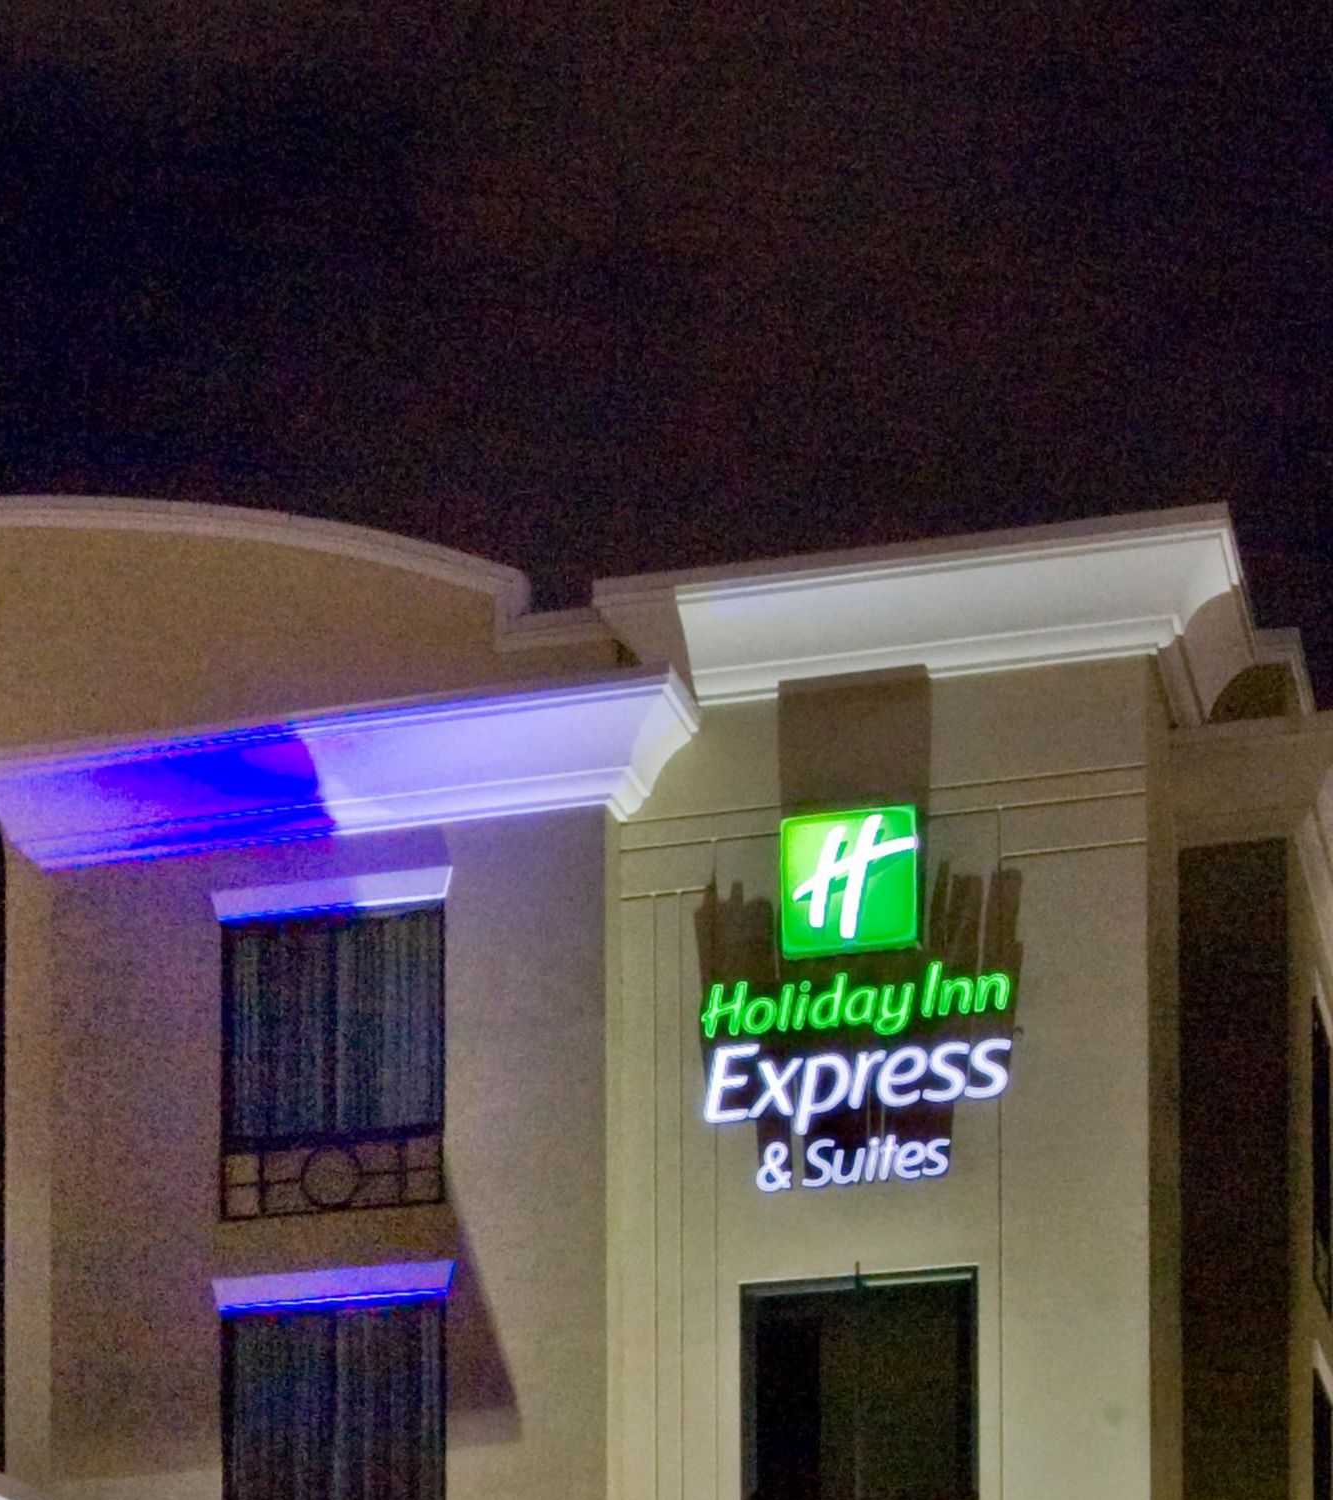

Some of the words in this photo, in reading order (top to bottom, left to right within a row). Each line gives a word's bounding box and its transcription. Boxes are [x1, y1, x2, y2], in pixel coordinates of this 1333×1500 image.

[701, 973, 915, 1038] Holiday
[921, 961, 1011, 1019] Inn
[703, 1038, 1013, 1136] Express
[756, 1142, 792, 1192] &
[802, 1134, 951, 1188] Suites
